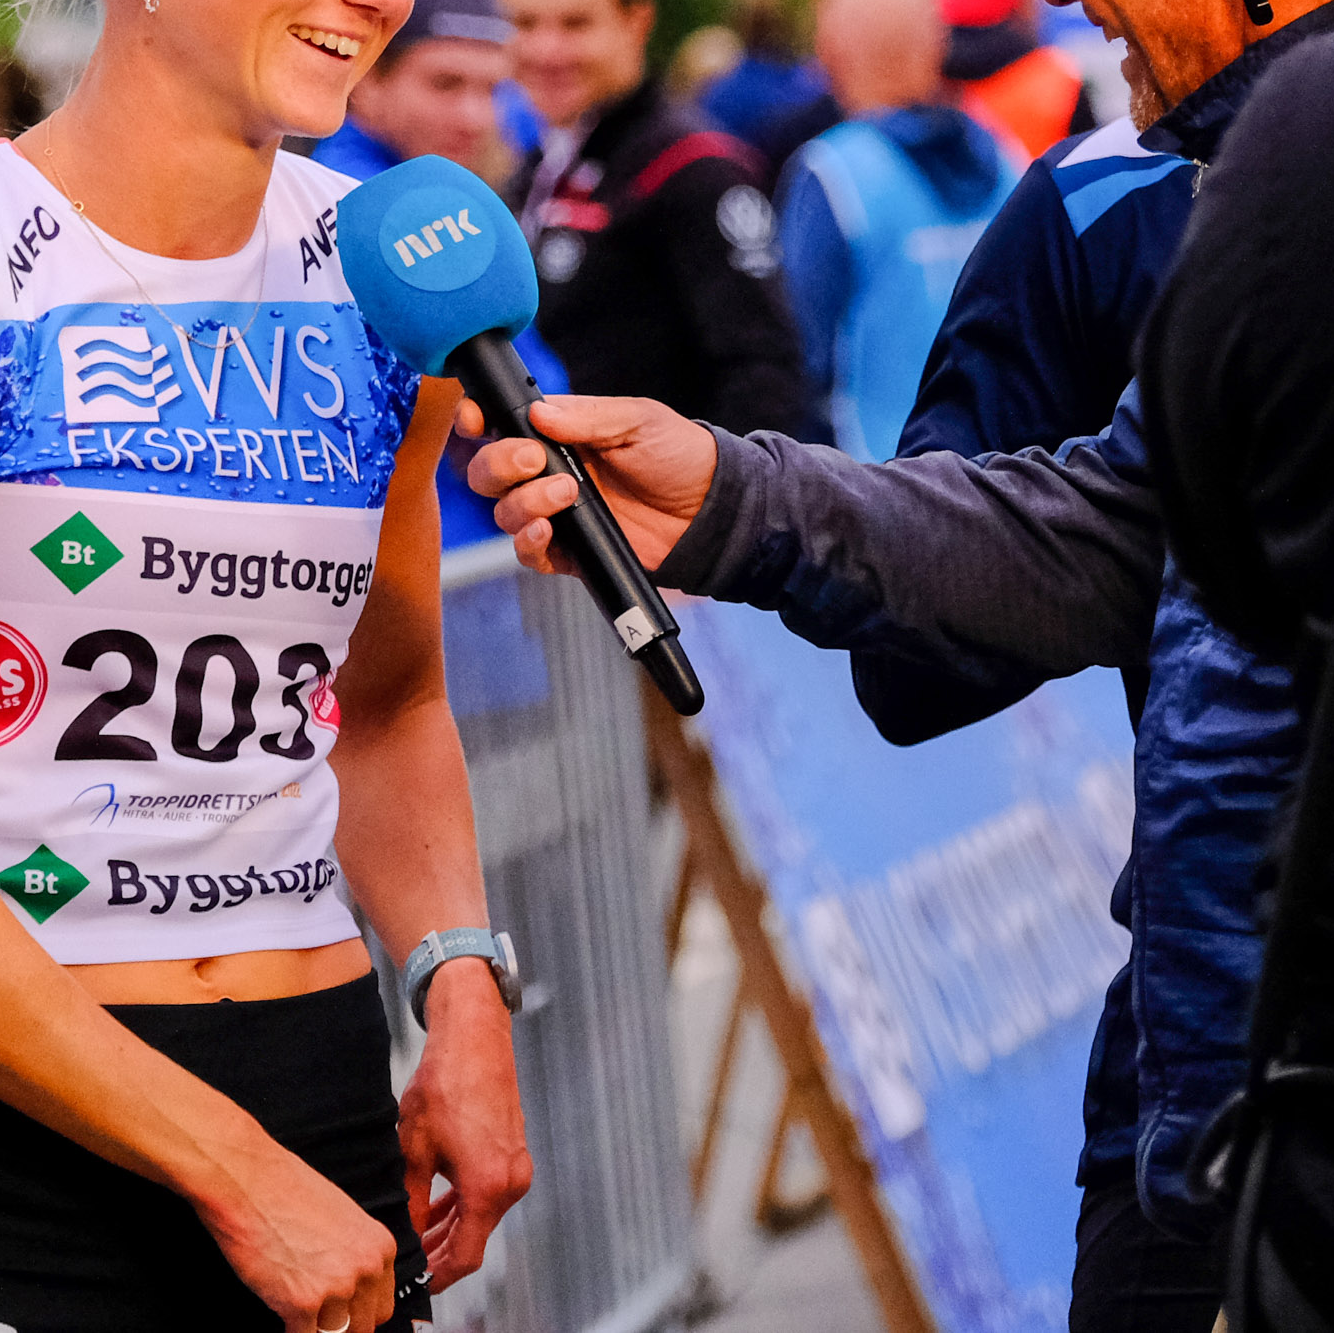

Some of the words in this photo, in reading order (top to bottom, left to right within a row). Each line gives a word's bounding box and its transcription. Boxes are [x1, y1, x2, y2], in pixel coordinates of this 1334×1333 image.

[172, 324, 345, 421] VVS
[67, 427, 360, 484] EKSPERTEN
[60, 539, 96, 566] Bt
[140, 536, 373, 607] Byggtorget
[626, 625, 642, 641] A
[54, 629, 331, 763] 203
[122, 809, 156, 820] HITRA
[162, 811, 193, 822] AURE
[23, 868, 59, 895] Bt
